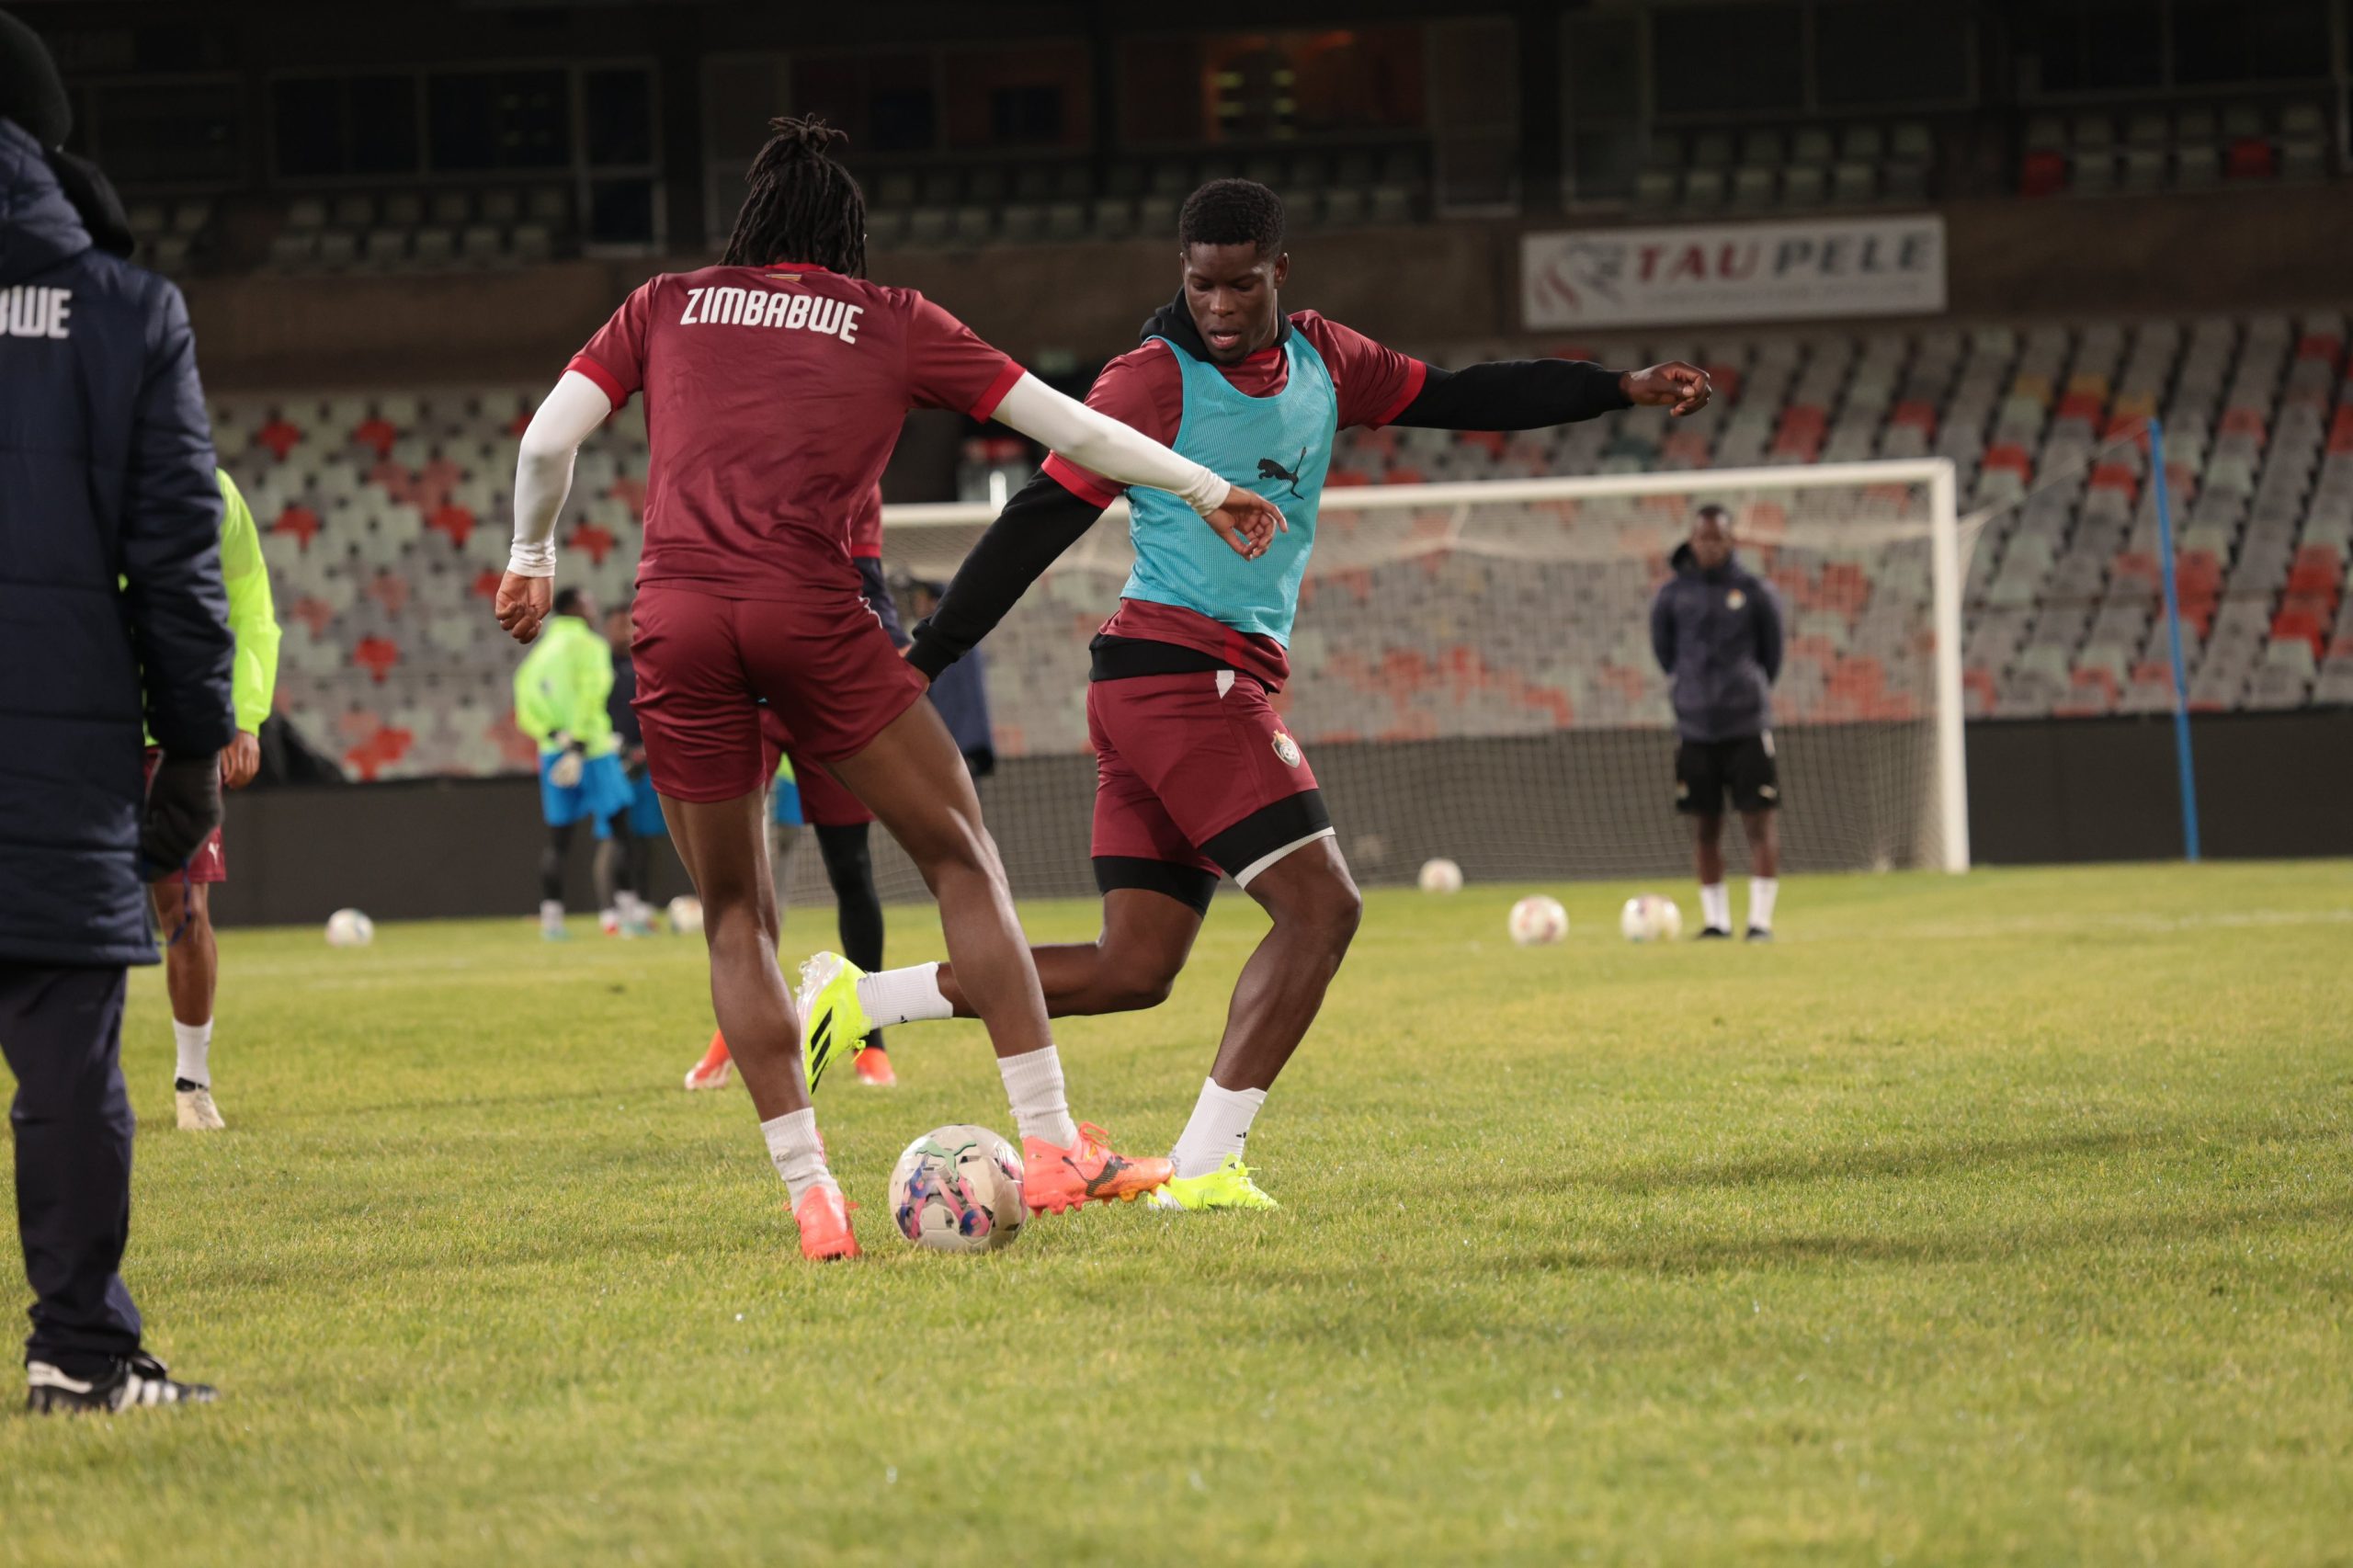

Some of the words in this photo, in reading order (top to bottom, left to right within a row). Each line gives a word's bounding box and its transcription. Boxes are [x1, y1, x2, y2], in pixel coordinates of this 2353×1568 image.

[1637, 240, 1763, 281] TAU
[1774, 232, 1934, 278] PELE
[680, 287, 864, 345] ZIMBABWE
